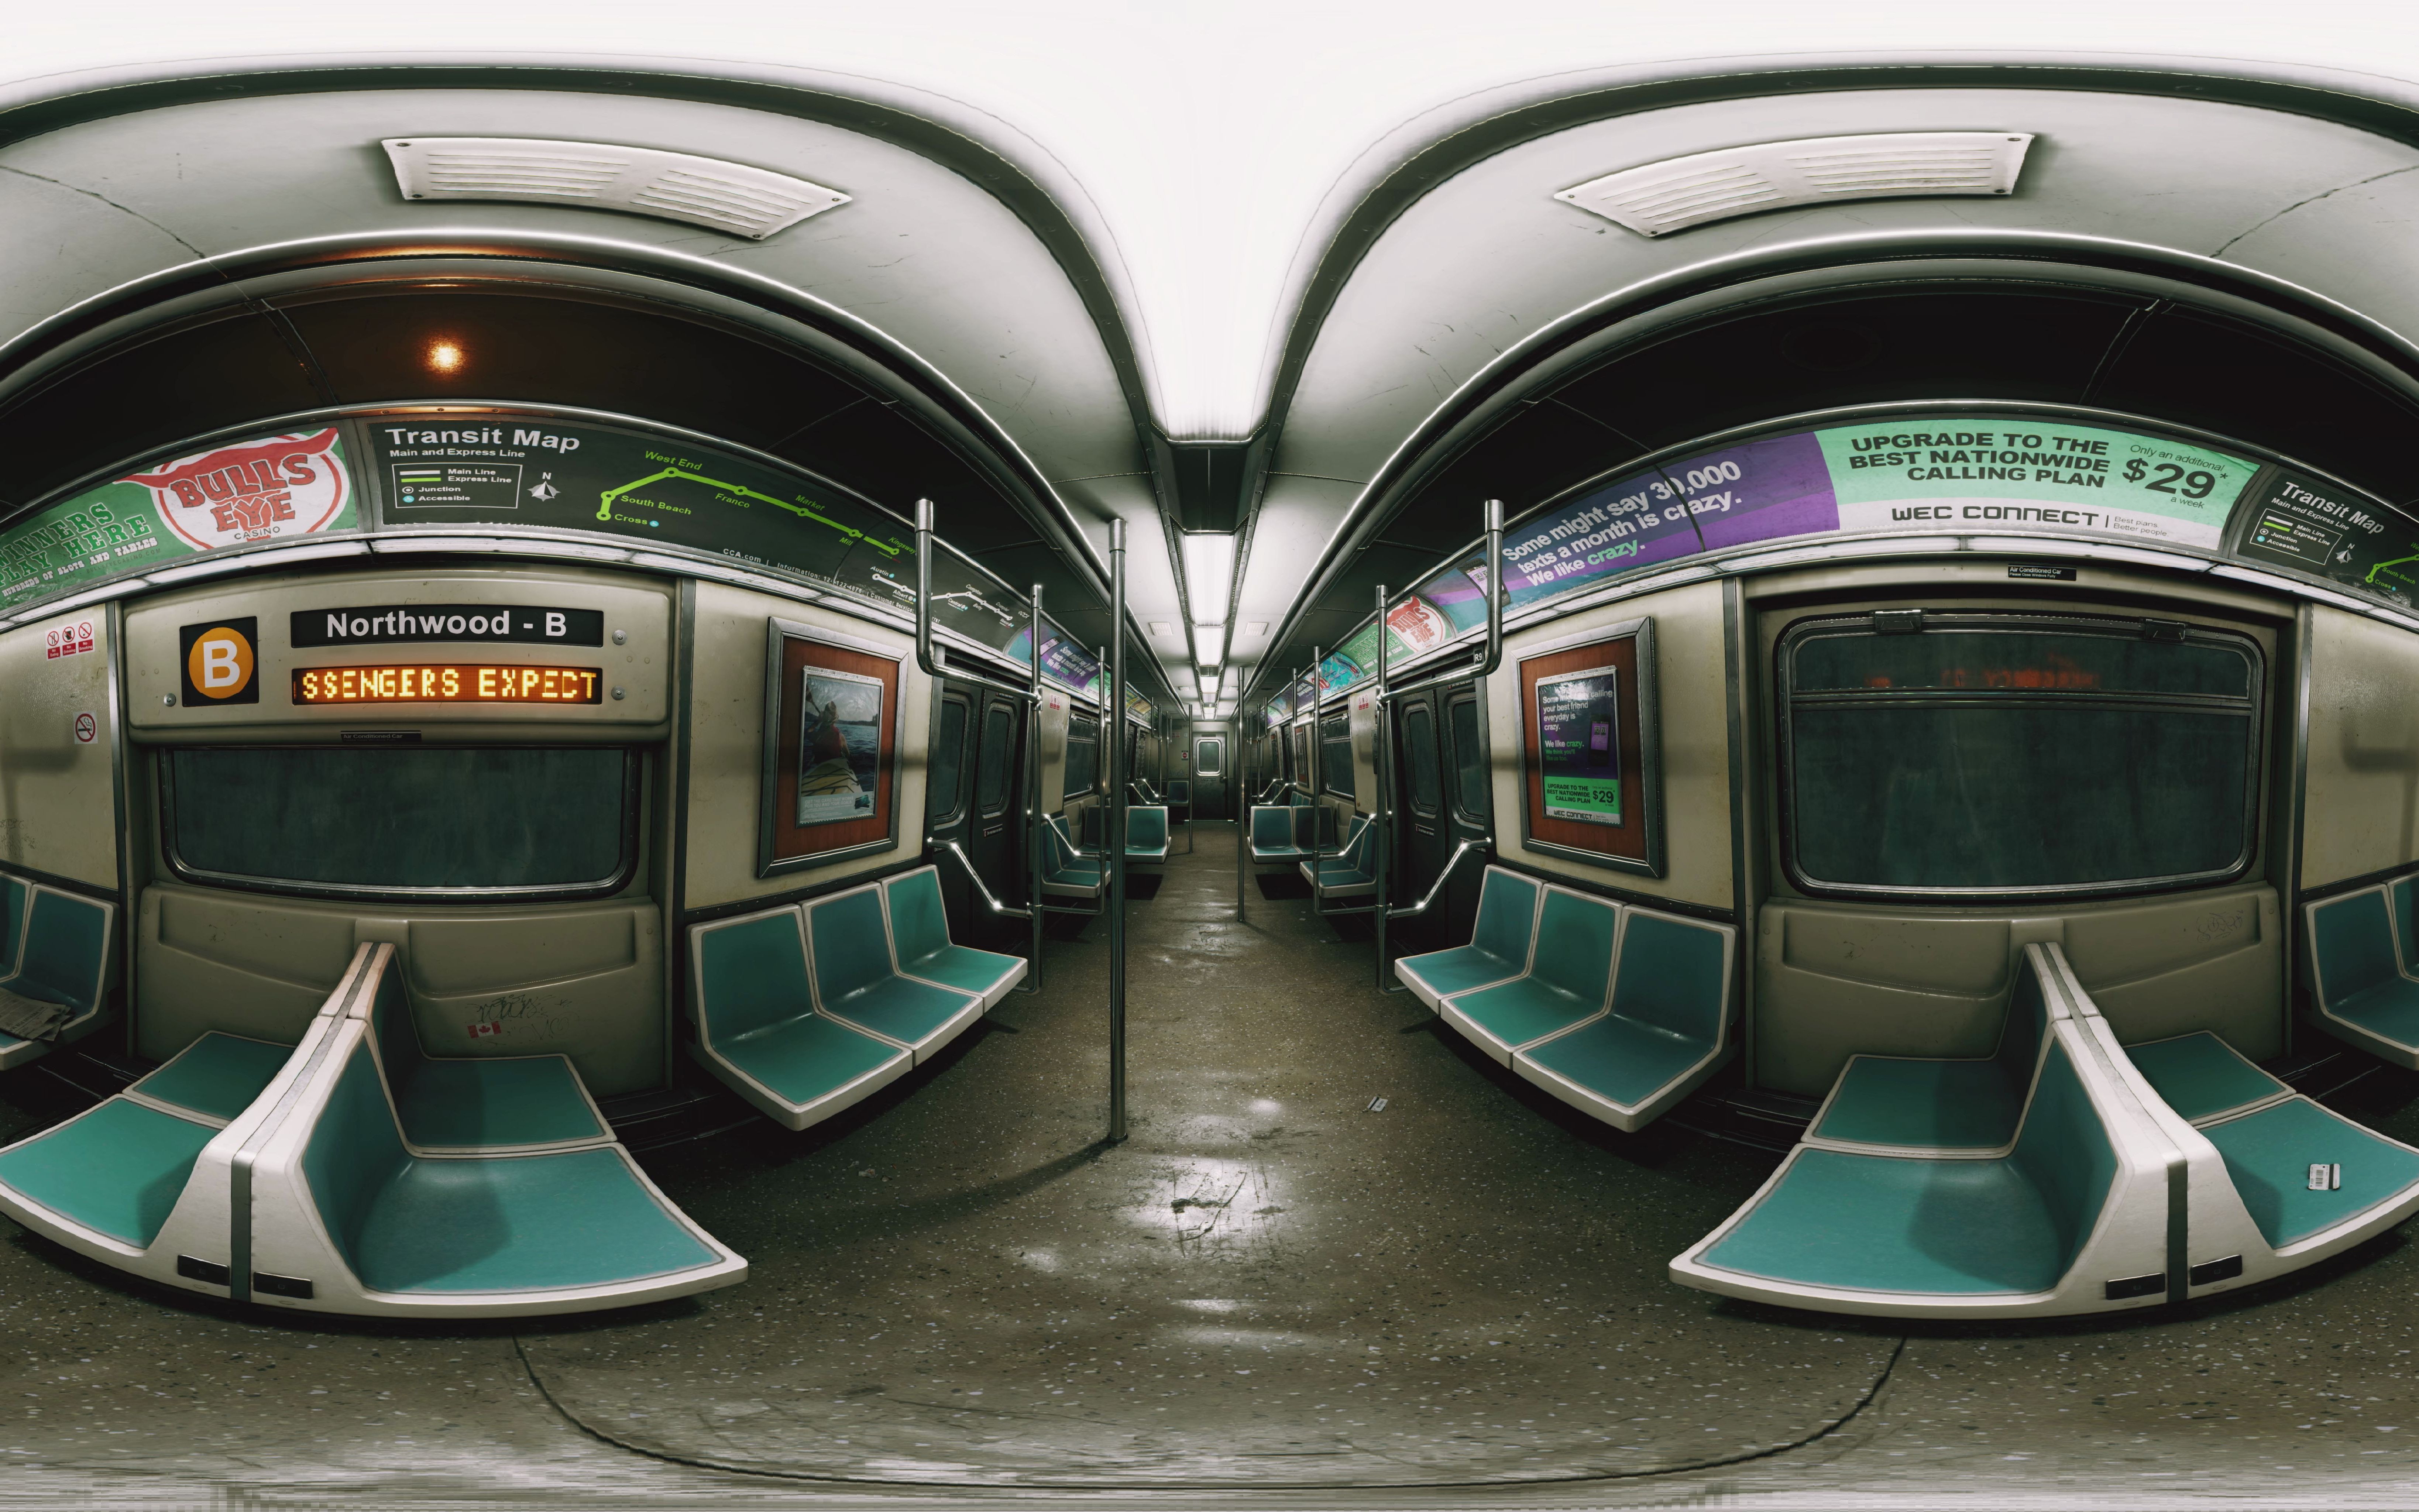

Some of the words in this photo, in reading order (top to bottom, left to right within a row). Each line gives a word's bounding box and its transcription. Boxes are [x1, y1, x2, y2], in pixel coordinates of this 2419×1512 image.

[385, 428, 502, 444] Transit
[513, 429, 580, 454] Map
[1851, 433, 1993, 452] UPGRADE
[2002, 434, 2043, 449] TO
[2052, 436, 2109, 456] THE
[390, 449, 418, 457] Main
[422, 448, 444, 456] and
[447, 448, 496, 458] Express
[499, 449, 525, 458] Line
[645, 450, 676, 464] West
[678, 458, 702, 471] End
[1849, 450, 1918, 469] BEST
[1930, 450, 2110, 474] NATIONWIDE
[2130, 444, 2157, 457] Only
[2175, 455, 2225, 472] additional
[170, 454, 316, 509] BULLS
[448, 475, 487, 484] Express
[1907, 466, 2026, 482] CALLING
[2035, 469, 2105, 488] PLAN
[621, 495, 654, 508] South
[658, 502, 692, 515] Beach
[715, 493, 750, 509] Franco
[796, 495, 826, 511] Market
[2180, 498, 2205, 509] week
[2281, 481, 2350, 518] Transit
[2348, 511, 2384, 535] Map
[210, 492, 296, 532] EYE
[614, 513, 647, 526] Cross
[1502, 534, 1551, 561] Some
[1549, 504, 1609, 541] might
[1607, 490, 1649, 517] say
[1650, 461, 1741, 500] 30,000
[1892, 506, 1952, 521] WEC
[1963, 506, 2099, 526] CONNECT
[2271, 497, 2291, 509] Main
[2291, 505, 2306, 514] and
[2307, 510, 2334, 525] Express
[2335, 520, 2350, 531] Line
[61, 514, 152, 559] HERE
[234, 526, 281, 540] CASINO
[1518, 551, 1557, 574] texts
[1557, 546, 1572, 558] a
[1570, 519, 1636, 553] month
[1637, 511, 1660, 532] is
[1664, 490, 1742, 522] crazy.
[2114, 523, 2139, 532] Better
[2141, 528, 2169, 537] people.
[2271, 531, 2298, 544] Junction
[2293, 530, 2316, 542] Express
[2318, 538, 2330, 546] Line
[2296, 525, 2311, 533] Main
[2312, 529, 2325, 538] Line
[839, 537, 854, 546] Mill
[888, 536, 916, 554] Kingsway
[2267, 539, 2300, 552] Accessible
[2, 577, 40, 597] HUNDREDS
[42, 571, 54, 581] OF
[57, 560, 85, 576] SLOTS
[89, 551, 110, 565] AND
[114, 537, 158, 557] TABLES
[870, 566, 890, 577] Austin
[1526, 569, 1554, 587] We
[1554, 559, 1585, 577] like
[1587, 540, 1646, 565] crazy.
[723, 549, 761, 563] CCA.com
[777, 562, 820, 580] Information:
[870, 593, 894, 605] Customer
[896, 602, 914, 613] Service:
[2375, 579, 2391, 589] Cross
[2382, 567, 2398, 577] South
[2399, 574, 2416, 584] Beach
[893, 589, 908, 599] Albert
[326, 610, 510, 638] Northwood
[545, 612, 567, 636] B
[1391, 607, 1430, 633] BULLS
[203, 639, 241, 689] B
[1355, 649, 1375, 664] PLAY
[1475, 653, 1482, 661] R9
[479, 669, 596, 699] EXPECT
[1571, 701, 1588, 709] friend
[1544, 713, 1569, 722] everyday
